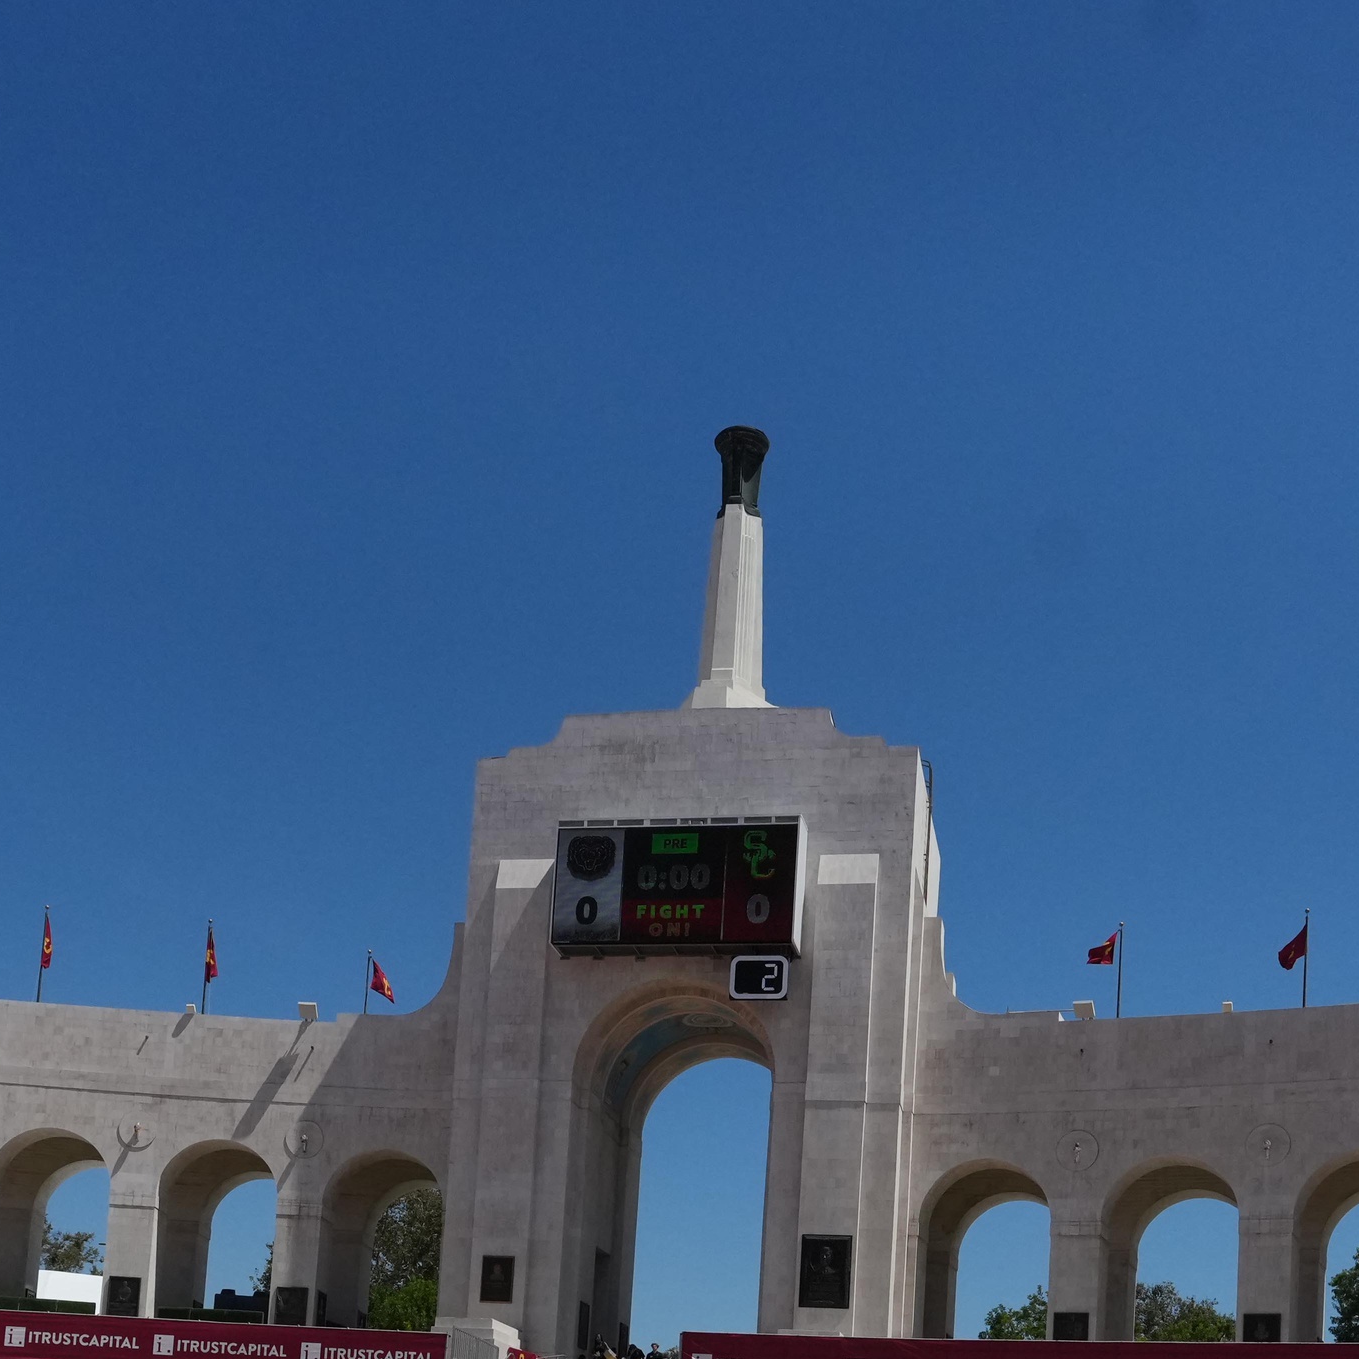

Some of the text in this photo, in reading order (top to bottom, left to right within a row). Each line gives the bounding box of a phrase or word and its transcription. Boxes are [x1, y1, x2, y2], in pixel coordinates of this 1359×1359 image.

[663, 838, 688, 850] PRE
[637, 863, 711, 891] 0:00
[575, 895, 598, 925] 0
[636, 903, 706, 919] FIGHT
[746, 894, 770, 925] 0
[649, 922, 691, 937] ON!
[761, 963, 778, 991] 2
[28, 1330, 140, 1350] ITRUSTCAPITAL
[176, 1339, 287, 1358] ITRUSTCAPITAL
